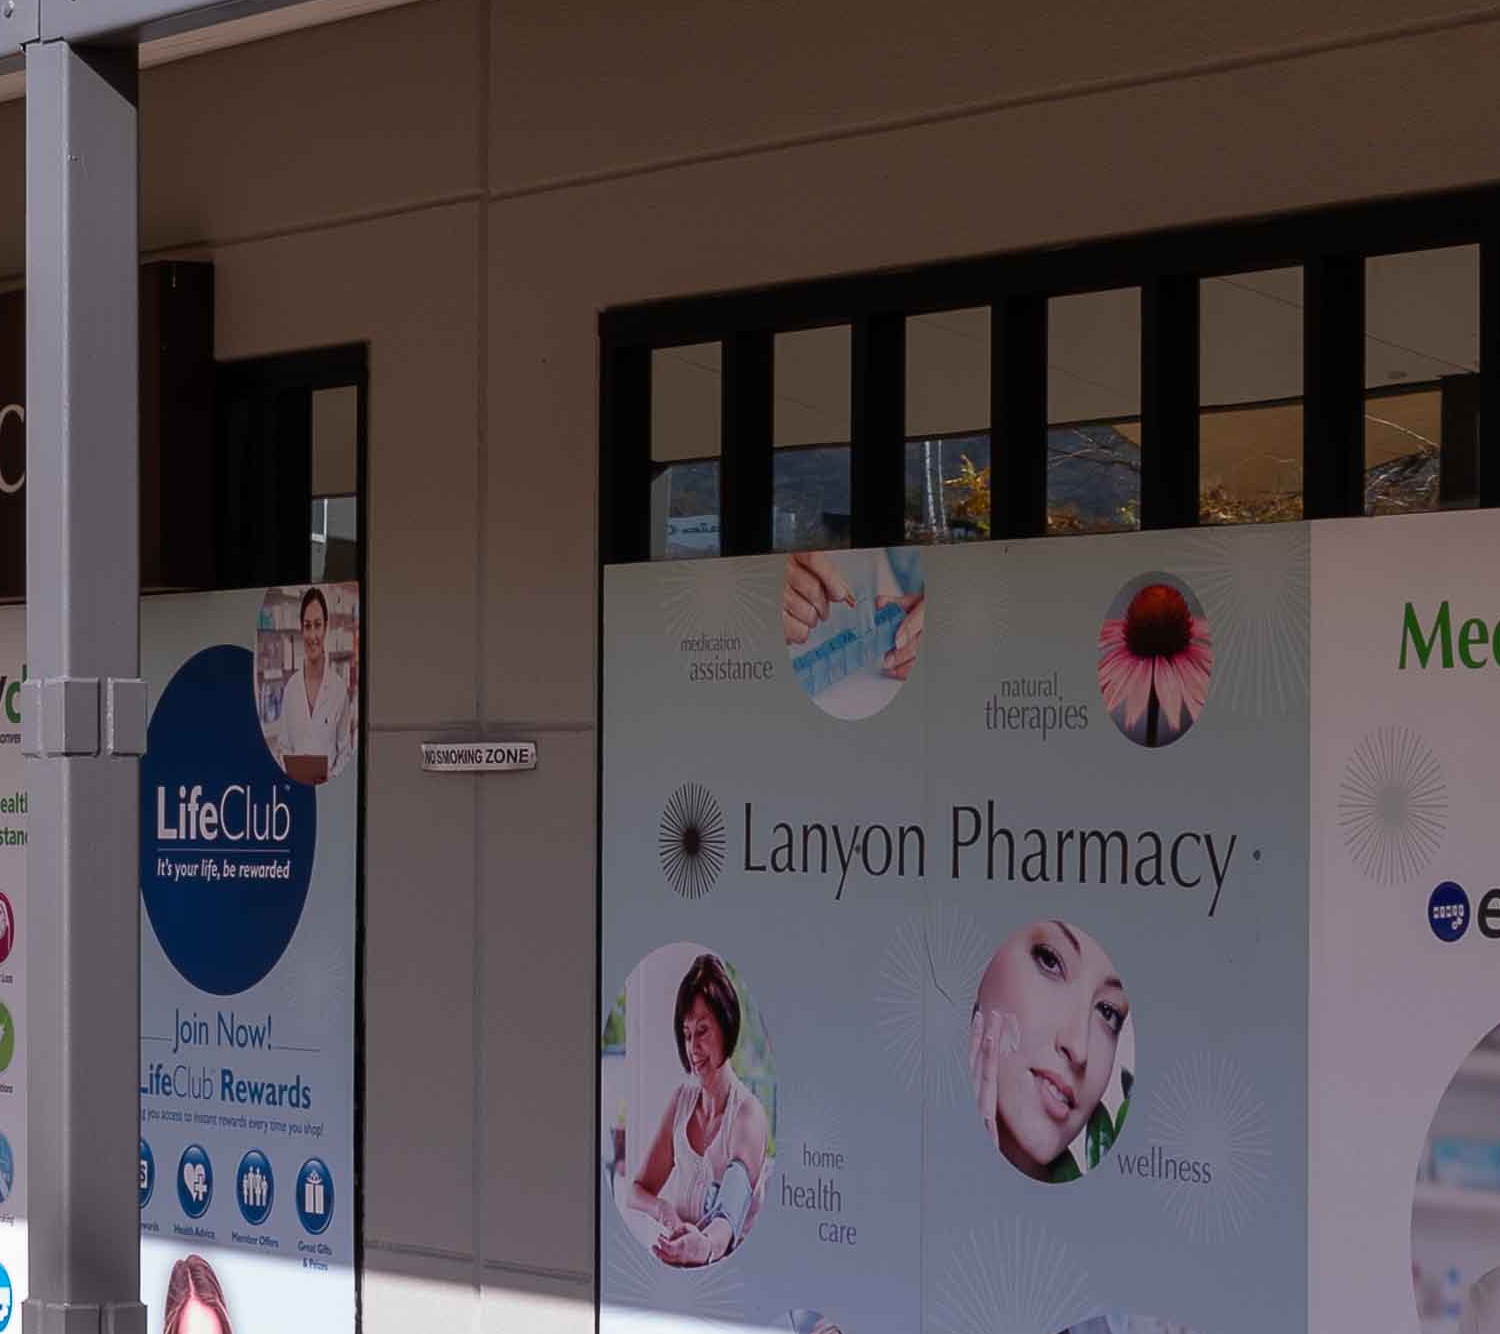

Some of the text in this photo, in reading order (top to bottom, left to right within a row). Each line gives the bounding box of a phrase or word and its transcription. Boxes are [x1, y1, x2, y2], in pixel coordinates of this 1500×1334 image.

[681, 634, 741, 652] medication
[690, 656, 773, 682] assistance
[1000, 672, 1060, 699] natural
[985, 696, 1089, 741] therapies
[424, 749, 529, 764] NO SMOKING ZONE
[157, 784, 291, 842] LifeClub
[157, 859, 290, 881] It's your life, be rewarded
[743, 800, 1237, 917] Lanyon Pharmacy
[173, 1008, 272, 1053] Join Now!
[221, 1067, 311, 1109] Rewards
[148, 1110, 160, 1122] you
[194, 1113, 217, 1125] instant
[218, 1115, 247, 1128] rewards
[248, 1119, 268, 1134] every
[270, 1120, 286, 1132] time
[288, 1123, 302, 1135] you
[802, 1142, 844, 1170] home
[1117, 1147, 1213, 1185] wellness
[781, 1176, 842, 1212] health
[174, 1224, 215, 1240] Health Advice
[231, 1231, 279, 1248] Member Offers
[817, 1218, 857, 1245] care
